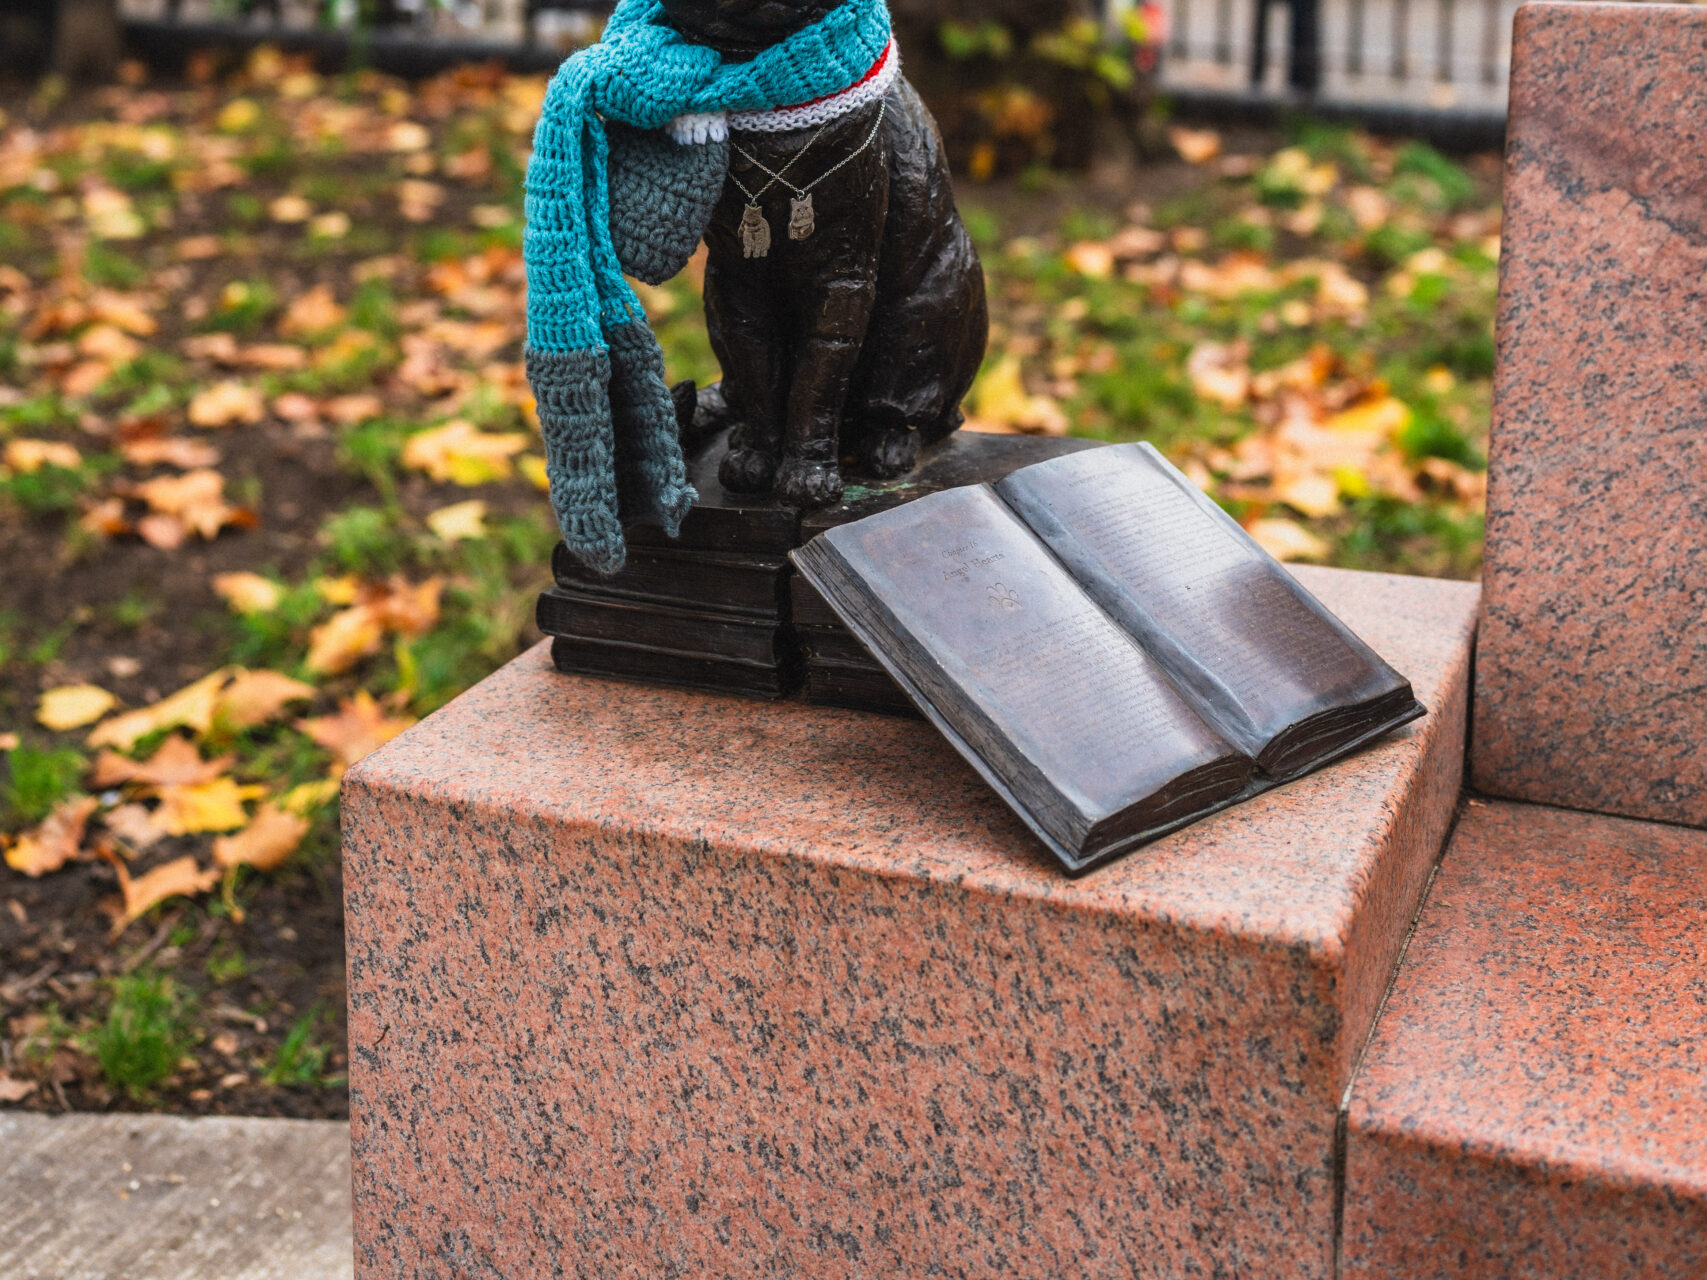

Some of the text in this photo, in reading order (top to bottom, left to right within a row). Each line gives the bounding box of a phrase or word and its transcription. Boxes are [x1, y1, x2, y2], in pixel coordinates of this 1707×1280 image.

[941, 545, 968, 561] Chapter
[942, 553, 1006, 580] Angel Hearts
